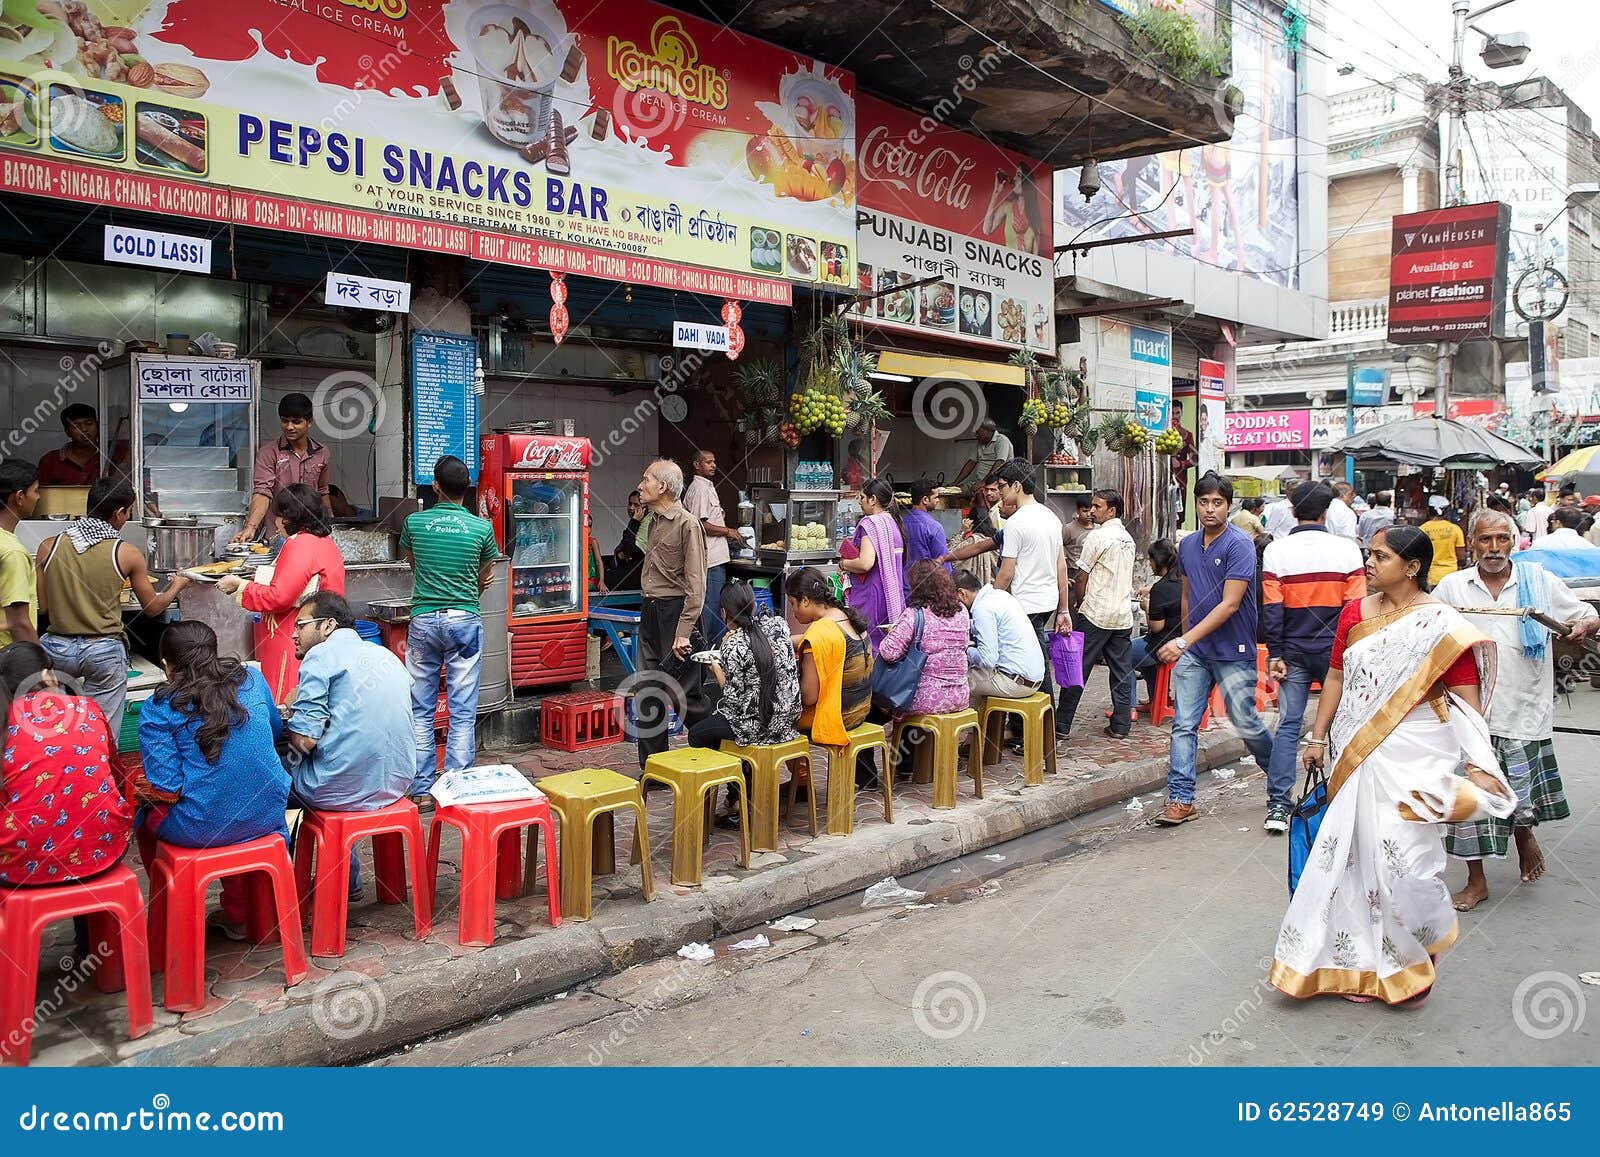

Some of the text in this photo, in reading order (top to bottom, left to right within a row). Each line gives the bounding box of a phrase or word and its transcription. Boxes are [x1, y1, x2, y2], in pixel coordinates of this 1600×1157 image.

[316, 4, 343, 22] ICE
[351, 14, 405, 39] CREAM
[639, 92, 727, 126] REAL ICE CREAM
[238, 113, 609, 222] PEPSI SNACKS BAR
[859, 126, 976, 210] Coca-Cola
[366, 184, 551, 227] AT YOUR SERVICE SINCE 1980
[428, 209, 459, 222] 15-16
[463, 215, 517, 232] BERTRAM
[445, 230, 467, 250] LASSI
[568, 220, 663, 246] WE HAVE NO BRANCH
[857, 210, 1042, 278] PUNJABI SNACKS
[113, 234, 203, 264] COLD LASSI
[479, 236, 504, 257] FRUIT
[1409, 259, 1474, 274] Available at
[336, 277, 402, 308] দই বড়া
[1396, 281, 1484, 302] planet Fashion
[421, 335, 468, 345] MENU
[678, 327, 699, 342] DAHI
[705, 330, 726, 346] VADA
[1133, 336, 1165, 359] mart
[141, 367, 192, 382] ছোলা
[144, 383, 195, 397] মশলা
[1225, 414, 1290, 430] PODDAR
[1224, 430, 1302, 447] REATIONS
[523, 439, 584, 464] Cocaola
[435, 526, 460, 534] Police
